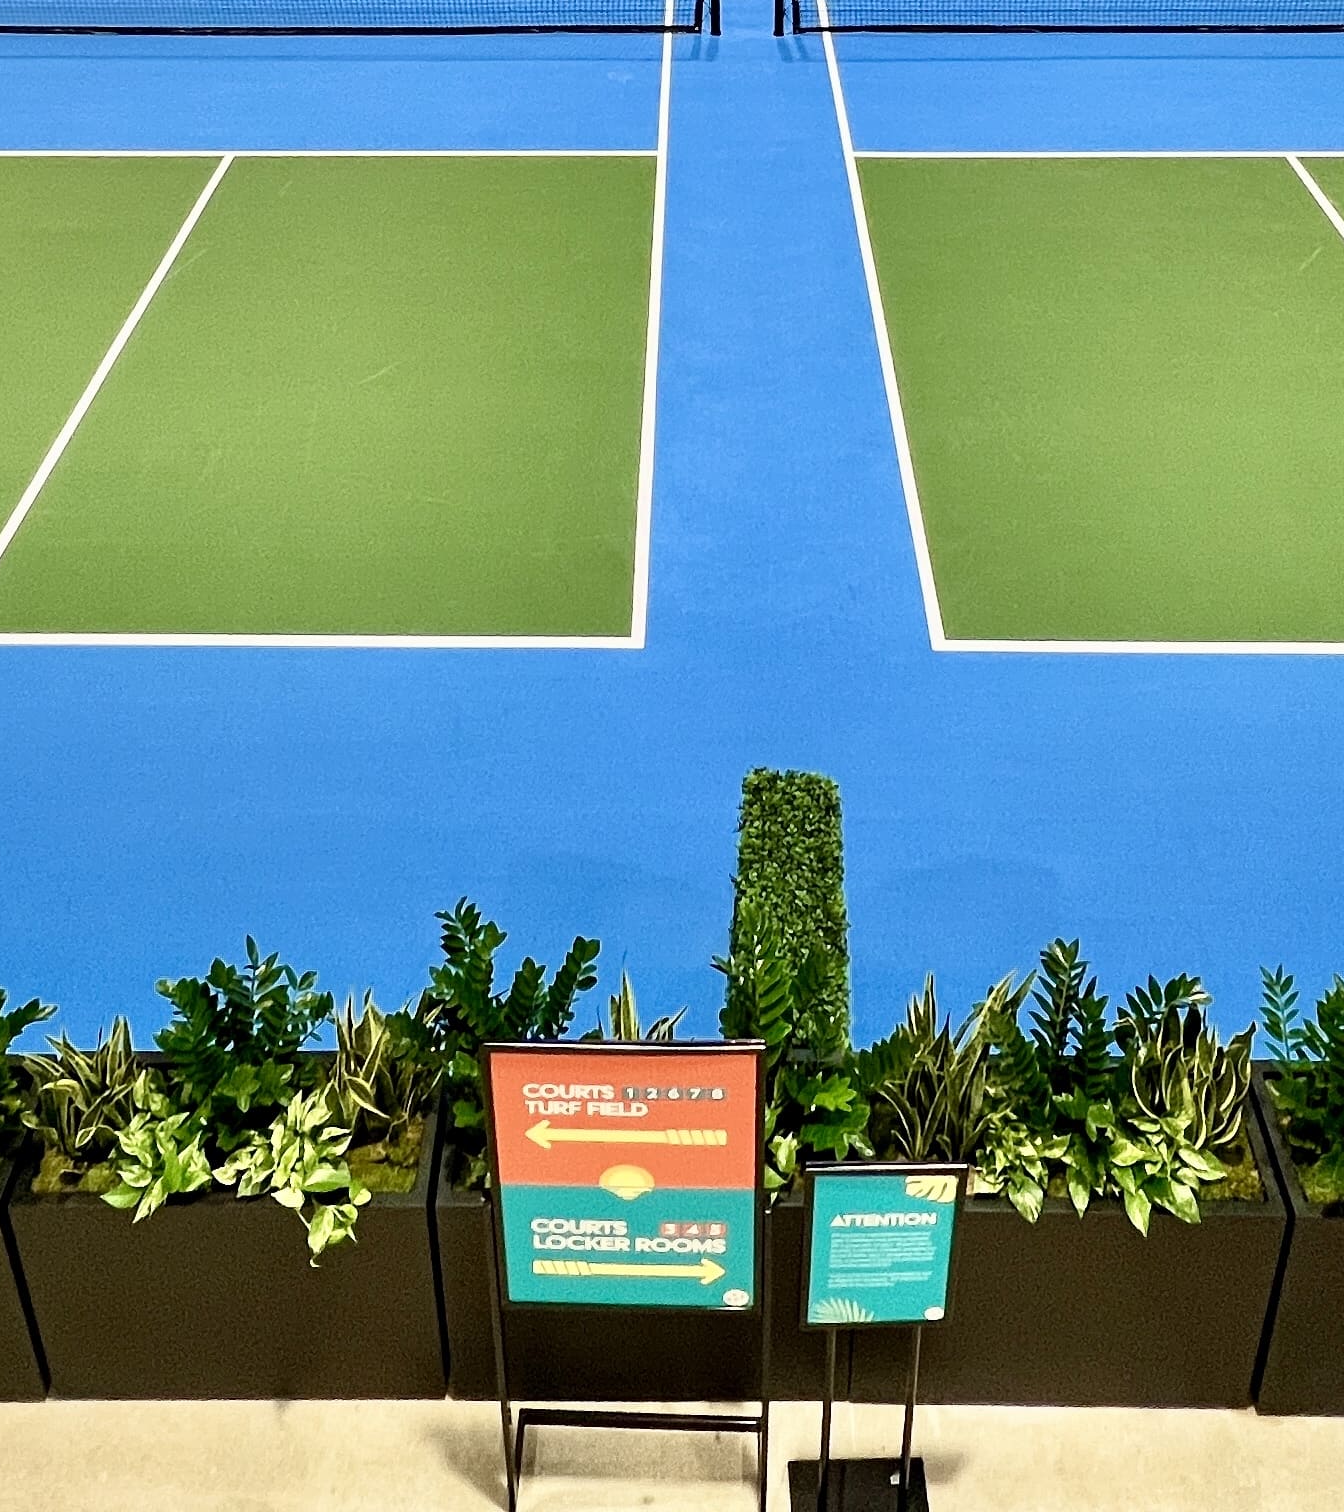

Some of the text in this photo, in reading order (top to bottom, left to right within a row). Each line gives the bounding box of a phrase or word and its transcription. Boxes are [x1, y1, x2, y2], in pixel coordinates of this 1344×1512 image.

[522, 1083, 724, 1100] COURTS 1 2 6 7 8
[525, 1100, 649, 1117] TURF FIELD
[531, 1218, 628, 1235] COURTS
[687, 1223, 700, 1235] 4
[830, 1212, 937, 1227] ATTENTION
[533, 1234, 727, 1254] LOCKER ROOMS
